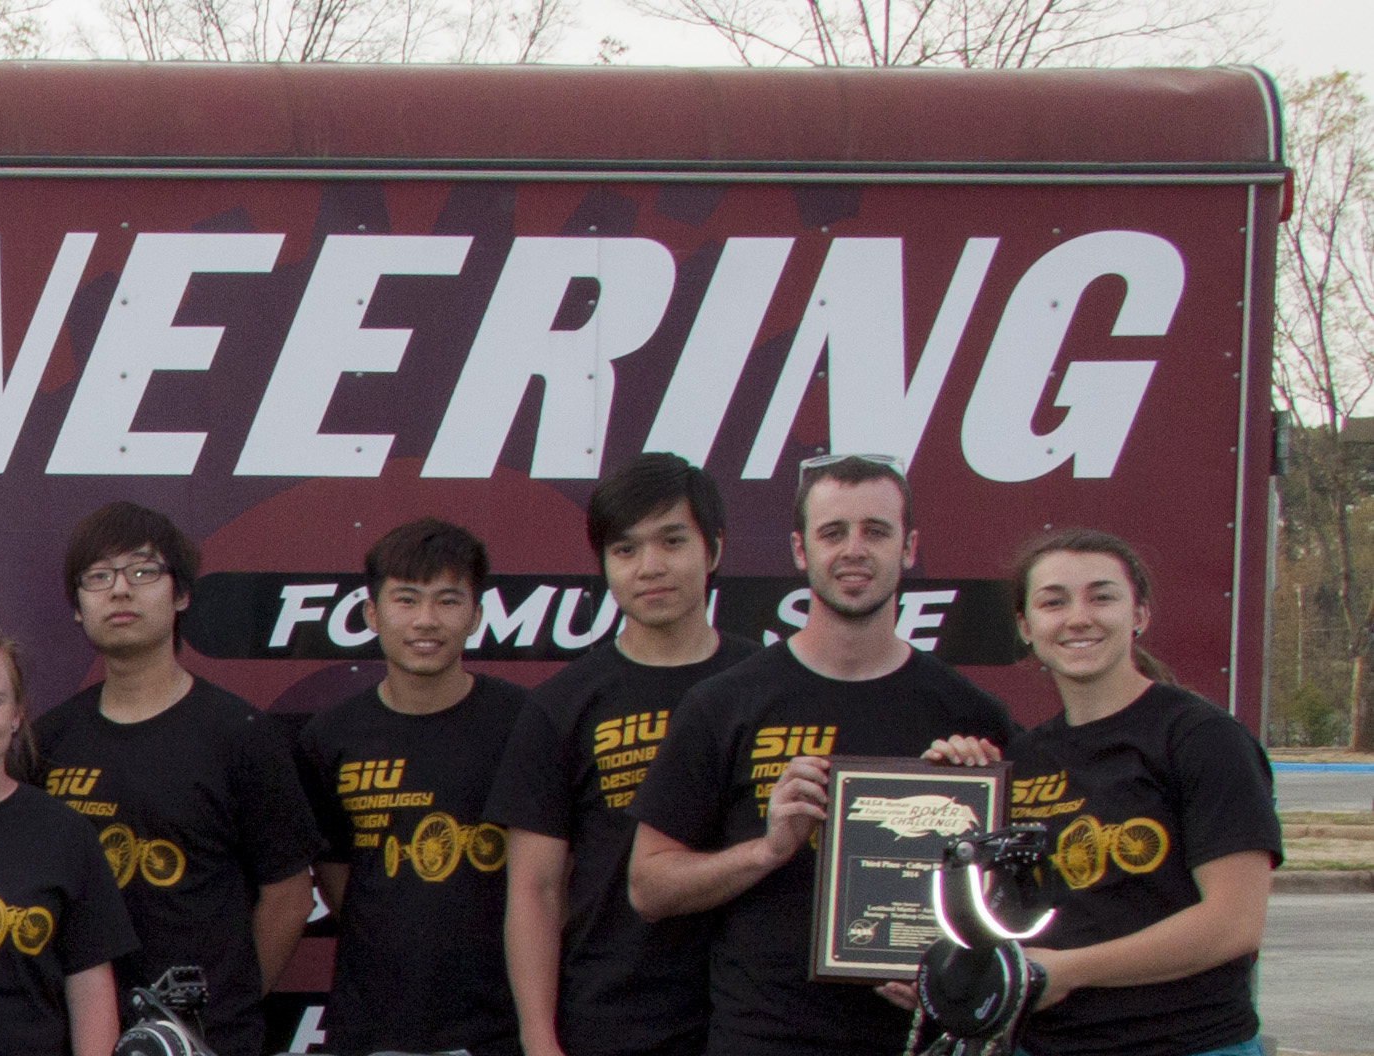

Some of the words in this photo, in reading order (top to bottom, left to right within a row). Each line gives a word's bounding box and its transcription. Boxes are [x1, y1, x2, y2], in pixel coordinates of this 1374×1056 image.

[267, 584, 717, 651] FOMU
[762, 586, 959, 652] SE
[594, 710, 669, 755] SIU
[751, 726, 838, 758] SIU
[596, 744, 659, 770] MOONB
[337, 758, 406, 794] SIU
[600, 766, 648, 790] DESIG
[856, 799, 884, 807] NASA
[909, 804, 960, 817] ROVER
[890, 816, 959, 828] CHALLENGE
